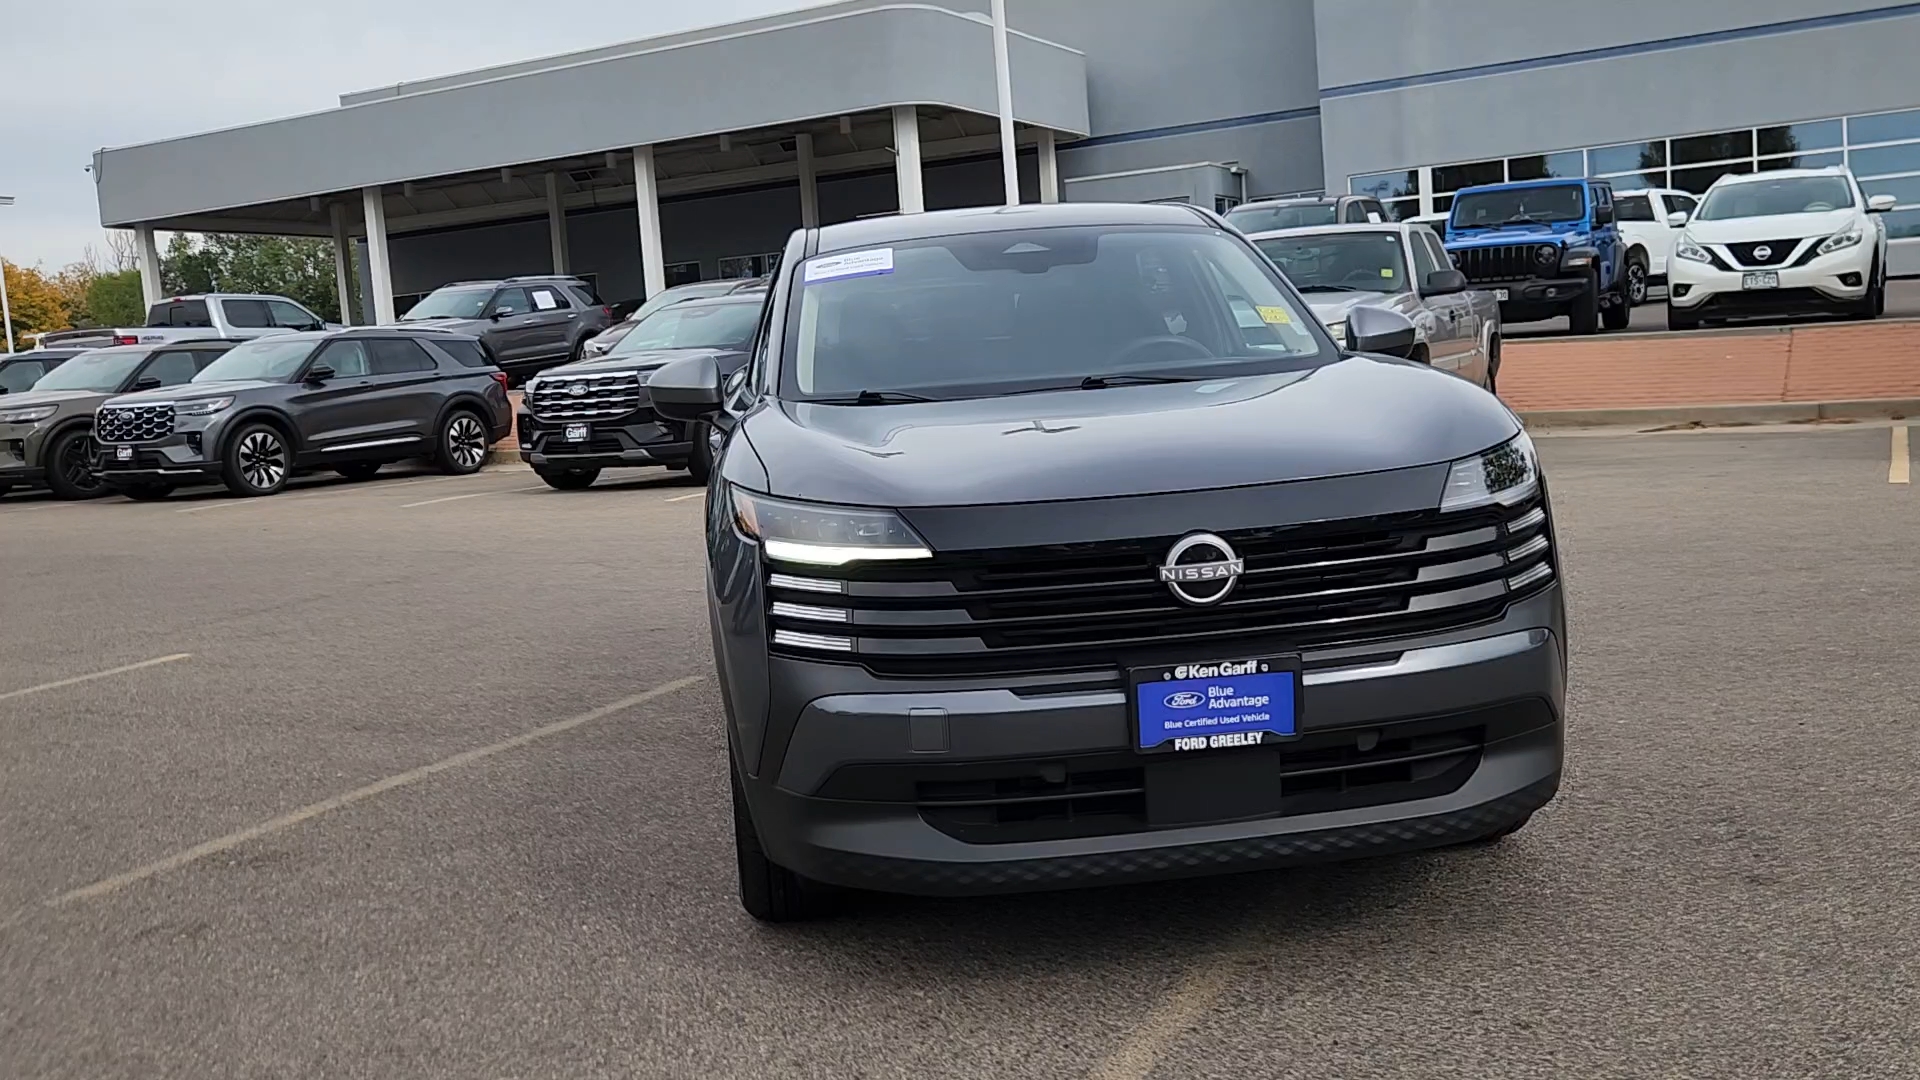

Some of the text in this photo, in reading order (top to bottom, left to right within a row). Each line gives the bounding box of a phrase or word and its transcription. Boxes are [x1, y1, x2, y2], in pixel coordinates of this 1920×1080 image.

[565, 427, 587, 438] Garff
[1161, 563, 1242, 580] NISSAN
[1189, 660, 1258, 678] Ken Garff
[1208, 686, 1234, 697] Blue
[1171, 694, 1198, 707] Ford
[1208, 695, 1270, 709] Advantage
[1164, 713, 1270, 729] Blue Certified Used Vehicle
[1174, 731, 1264, 751] FORD GREELEY
